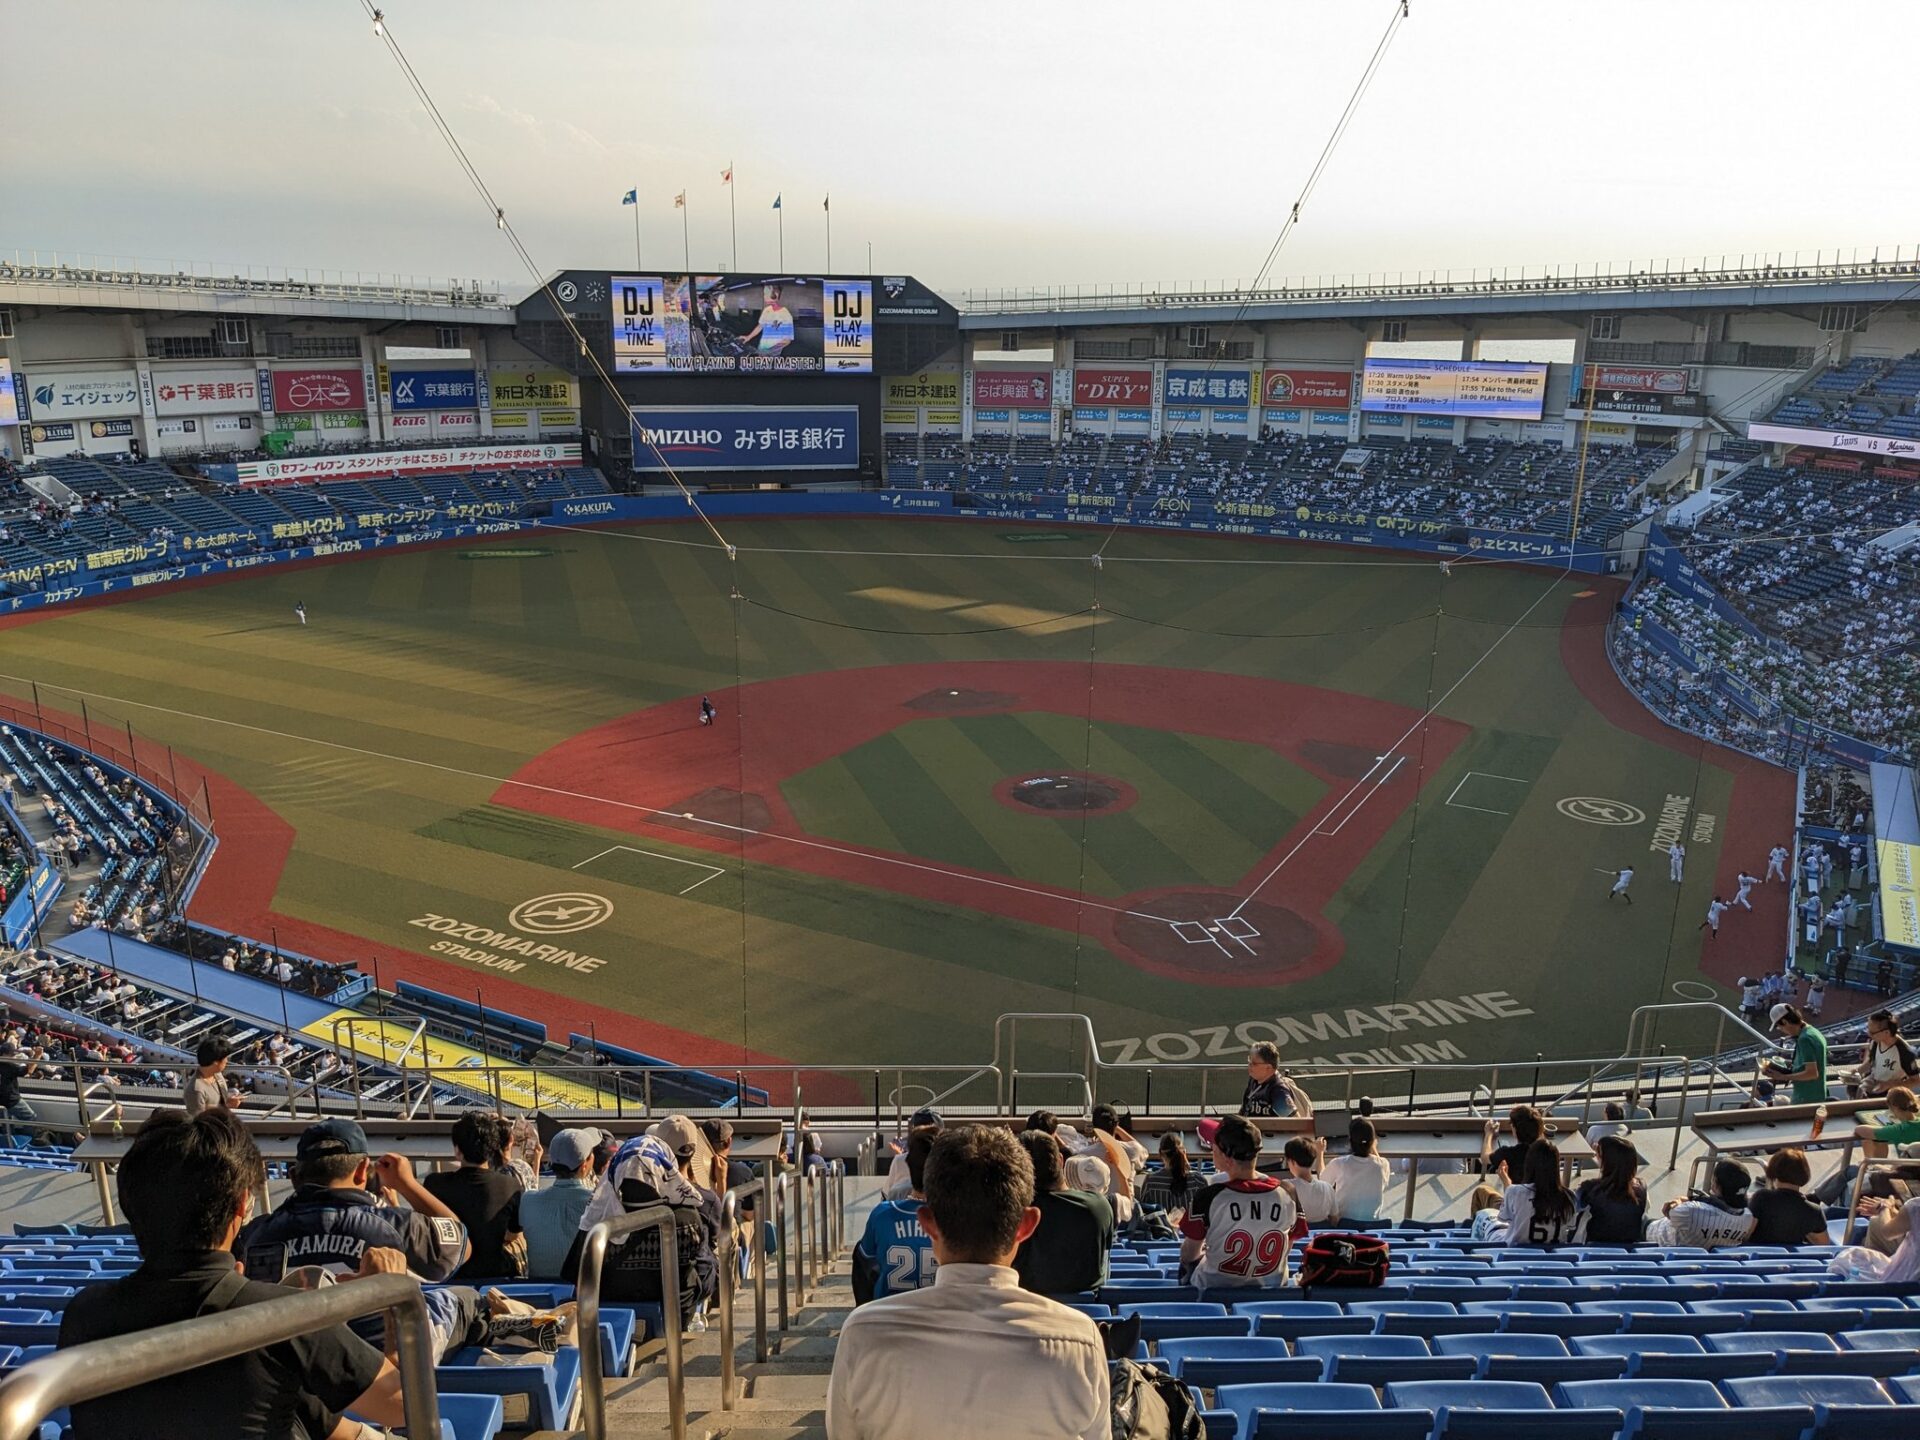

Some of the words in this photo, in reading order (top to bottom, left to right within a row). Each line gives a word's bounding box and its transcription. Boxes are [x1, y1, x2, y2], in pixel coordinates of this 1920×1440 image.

[623, 287, 654, 315] DJ
[834, 290, 862, 318] DJ
[625, 318, 654, 331] PLAY
[834, 320, 862, 333] PLAY
[626, 333, 654, 346] TIME
[835, 335, 862, 347] TIME
[669, 357, 694, 370] NOW
[695, 357, 735, 370] PLAYING
[740, 357, 753, 370] DJ
[774, 357, 814, 370] MASTER
[1434, 365, 1471, 373] SCHEDULE
[1102, 375, 1130, 383] SUPER
[143, 381, 156, 406] HTS
[177, 382, 254, 401] 千葉銀行
[424, 383, 475, 397] 京葉銀行
[495, 384, 568, 400] 新日本建設
[890, 385, 957, 398] 新日本建設
[977, 385, 1029, 398] ちば興銀
[1167, 378, 1248, 399] 京成電鉄
[61, 390, 137, 406] エイジェック
[646, 429, 722, 444] MIZUHO
[734, 428, 846, 450] みずほ銀行
[1867, 439, 1878, 450] VS
[1886, 441, 1916, 454] Marines
[459, 448, 541, 462] チケットのお求めは
[573, 501, 614, 513] KAKUTA
[1080, 495, 1116, 507] 新昭和
[1225, 503, 1277, 517] 新宿健診
[1312, 510, 1367, 526] 古谷式典
[357, 508, 436, 529] 東京インテリア
[271, 516, 346, 540] 東進ハイスクール
[1224, 524, 1255, 534] 新宿健診
[1309, 531, 1342, 541] 古谷式典
[194, 529, 257, 550] 金太郎ホーム
[396, 530, 443, 545] 東京インテリア
[87, 540, 169, 571] 新東京グループ
[312, 539, 362, 557] 東進ハイスクール
[235, 554, 276, 568] 金太郎ホーム
[132, 566, 187, 587] 新東京グループ
[45, 587, 84, 603] カナデン
[1692, 813, 1717, 844] STADIUM
[407, 913, 609, 973] ZOZOMARINE
[429, 940, 527, 973] STADIUM
[1100, 990, 1535, 1065] ZOZOMARINE
[1283, 1039, 1467, 1074] TADIUM
[1229, 1201, 1282, 1222] ONO
[1218, 1228, 1285, 1277] 29
